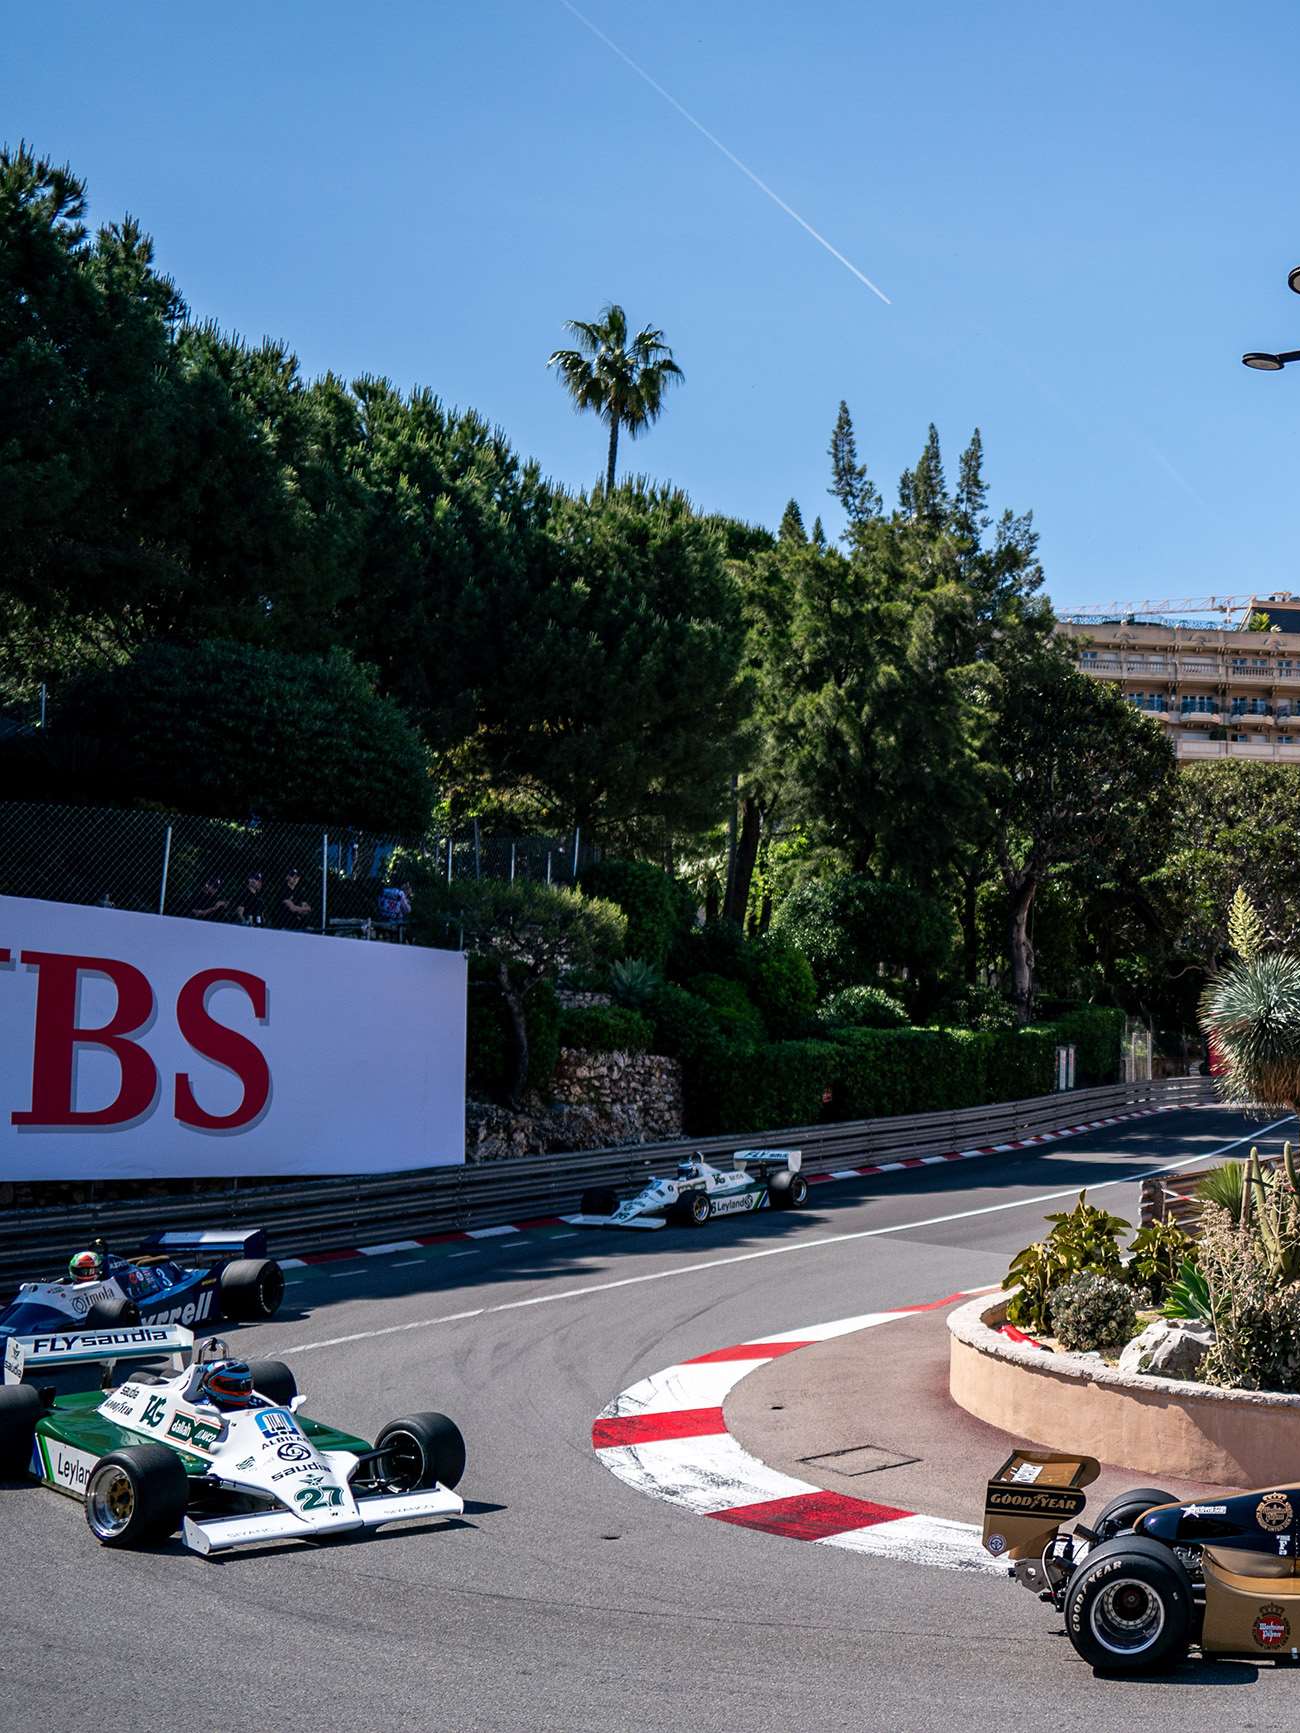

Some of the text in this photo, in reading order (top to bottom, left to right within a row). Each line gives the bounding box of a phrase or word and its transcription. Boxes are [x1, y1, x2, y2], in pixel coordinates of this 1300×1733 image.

[0, 948, 270, 1130] BS
[717, 1200, 745, 1212] Leyland
[85, 1286, 115, 1306] imola
[141, 1290, 213, 1327] yrrell
[139, 1394, 168, 1427] TAG
[261, 1435, 311, 1450] ALBILA
[57, 1452, 92, 1486] Leylan
[271, 1462, 332, 1482] saudia
[294, 1484, 345, 1512] 27
[990, 1491, 1077, 1511] GOODYEAR
